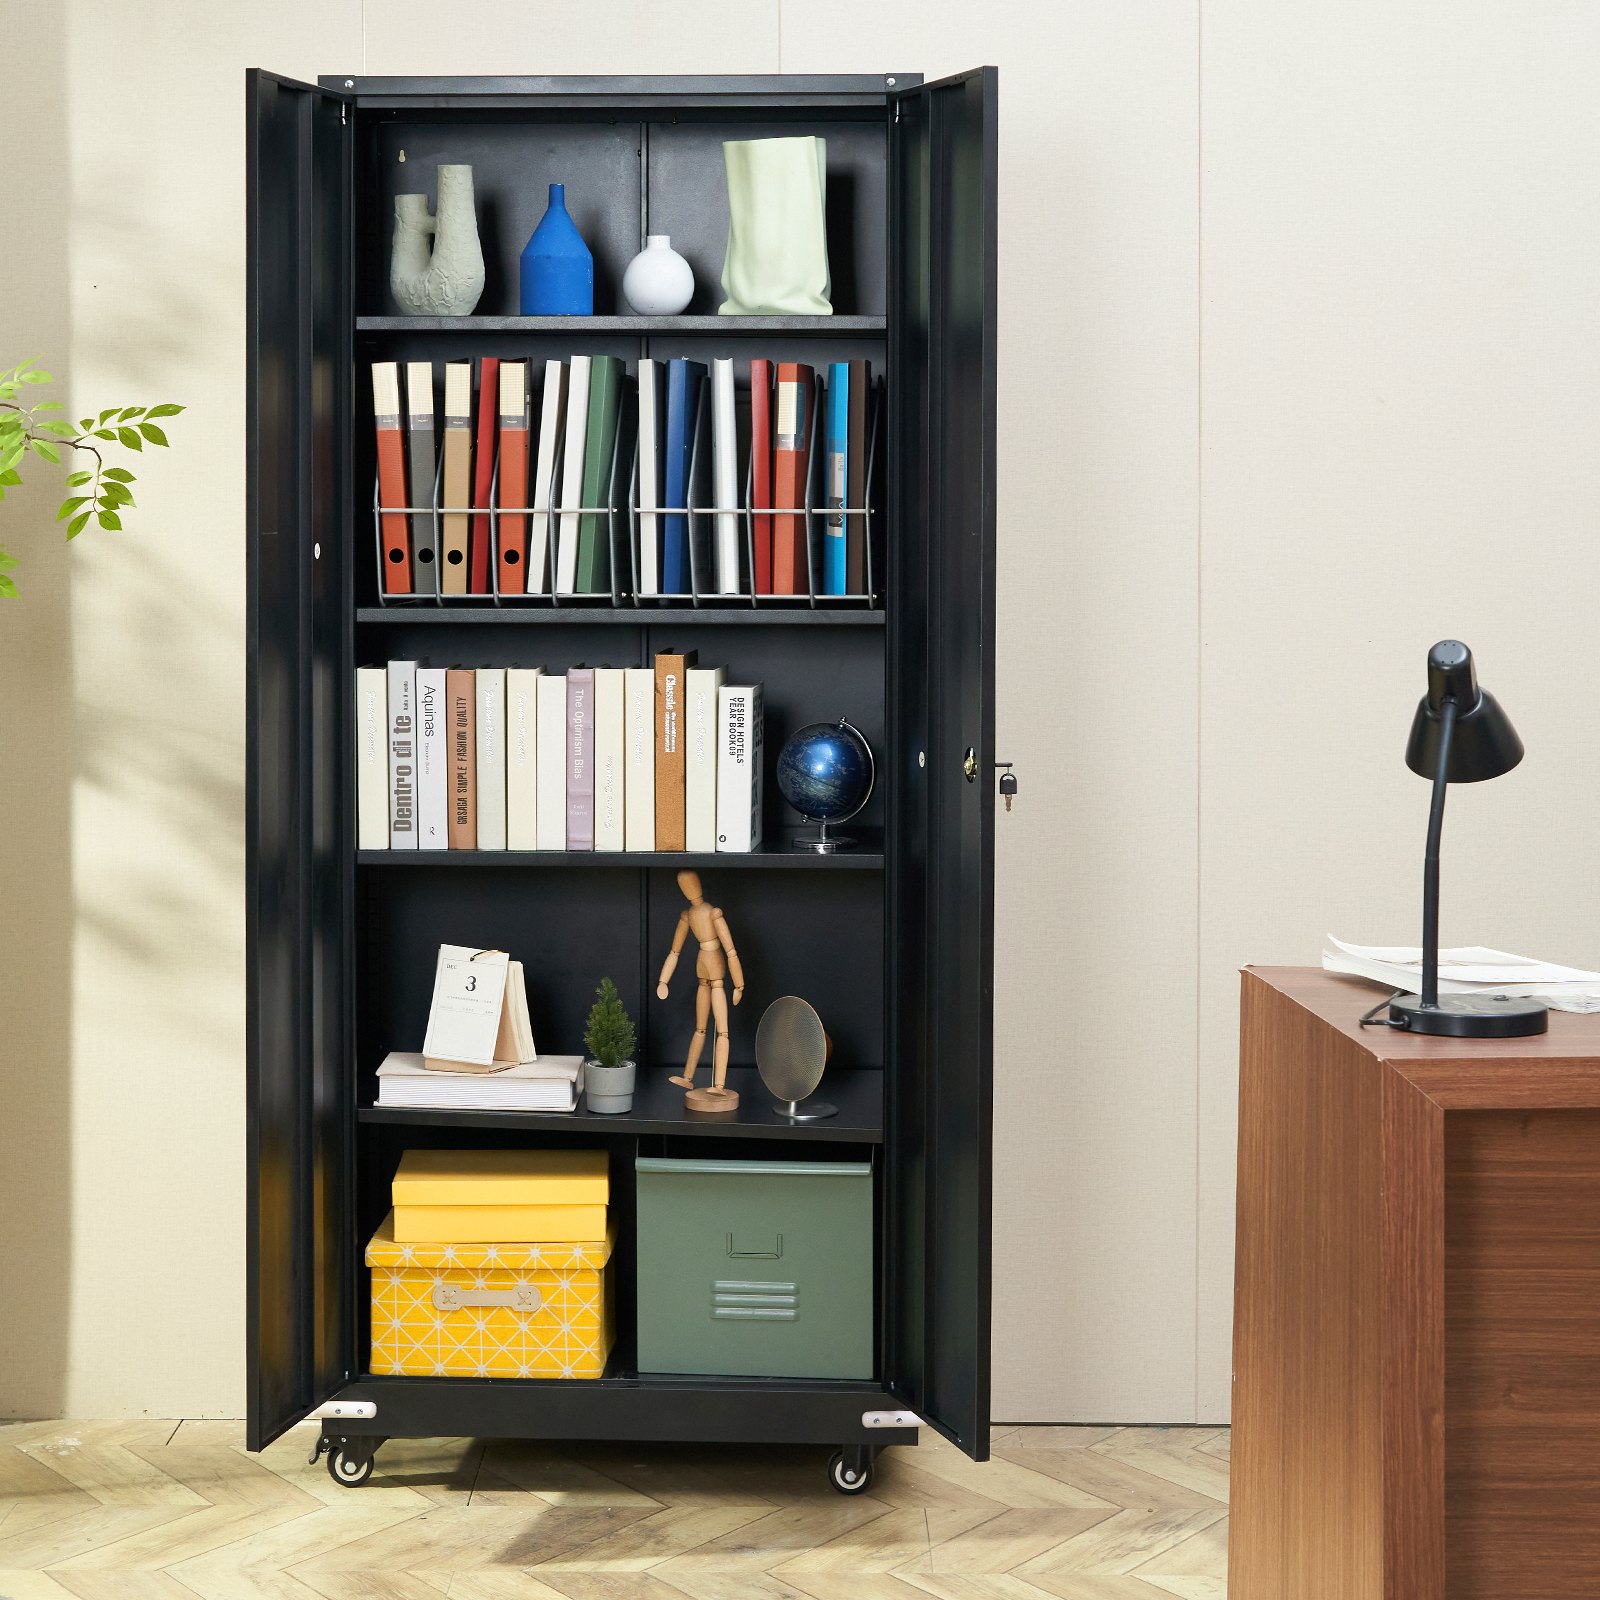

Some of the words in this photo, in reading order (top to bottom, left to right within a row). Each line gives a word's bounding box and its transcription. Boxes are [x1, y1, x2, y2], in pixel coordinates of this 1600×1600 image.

[420, 685, 437, 737] Aquinas
[457, 697, 467, 728] QUALITY
[575, 689, 584, 708] The
[393, 715, 412, 735] te
[573, 712, 584, 755] Optimism
[393, 741, 411, 757] di
[457, 731, 467, 762] FASHION
[736, 731, 744, 764] HOTELS
[457, 766, 468, 793] SIMPLE
[575, 760, 584, 779] Bias
[393, 765, 412, 832] Dentro
[465, 976, 477, 991] 3
